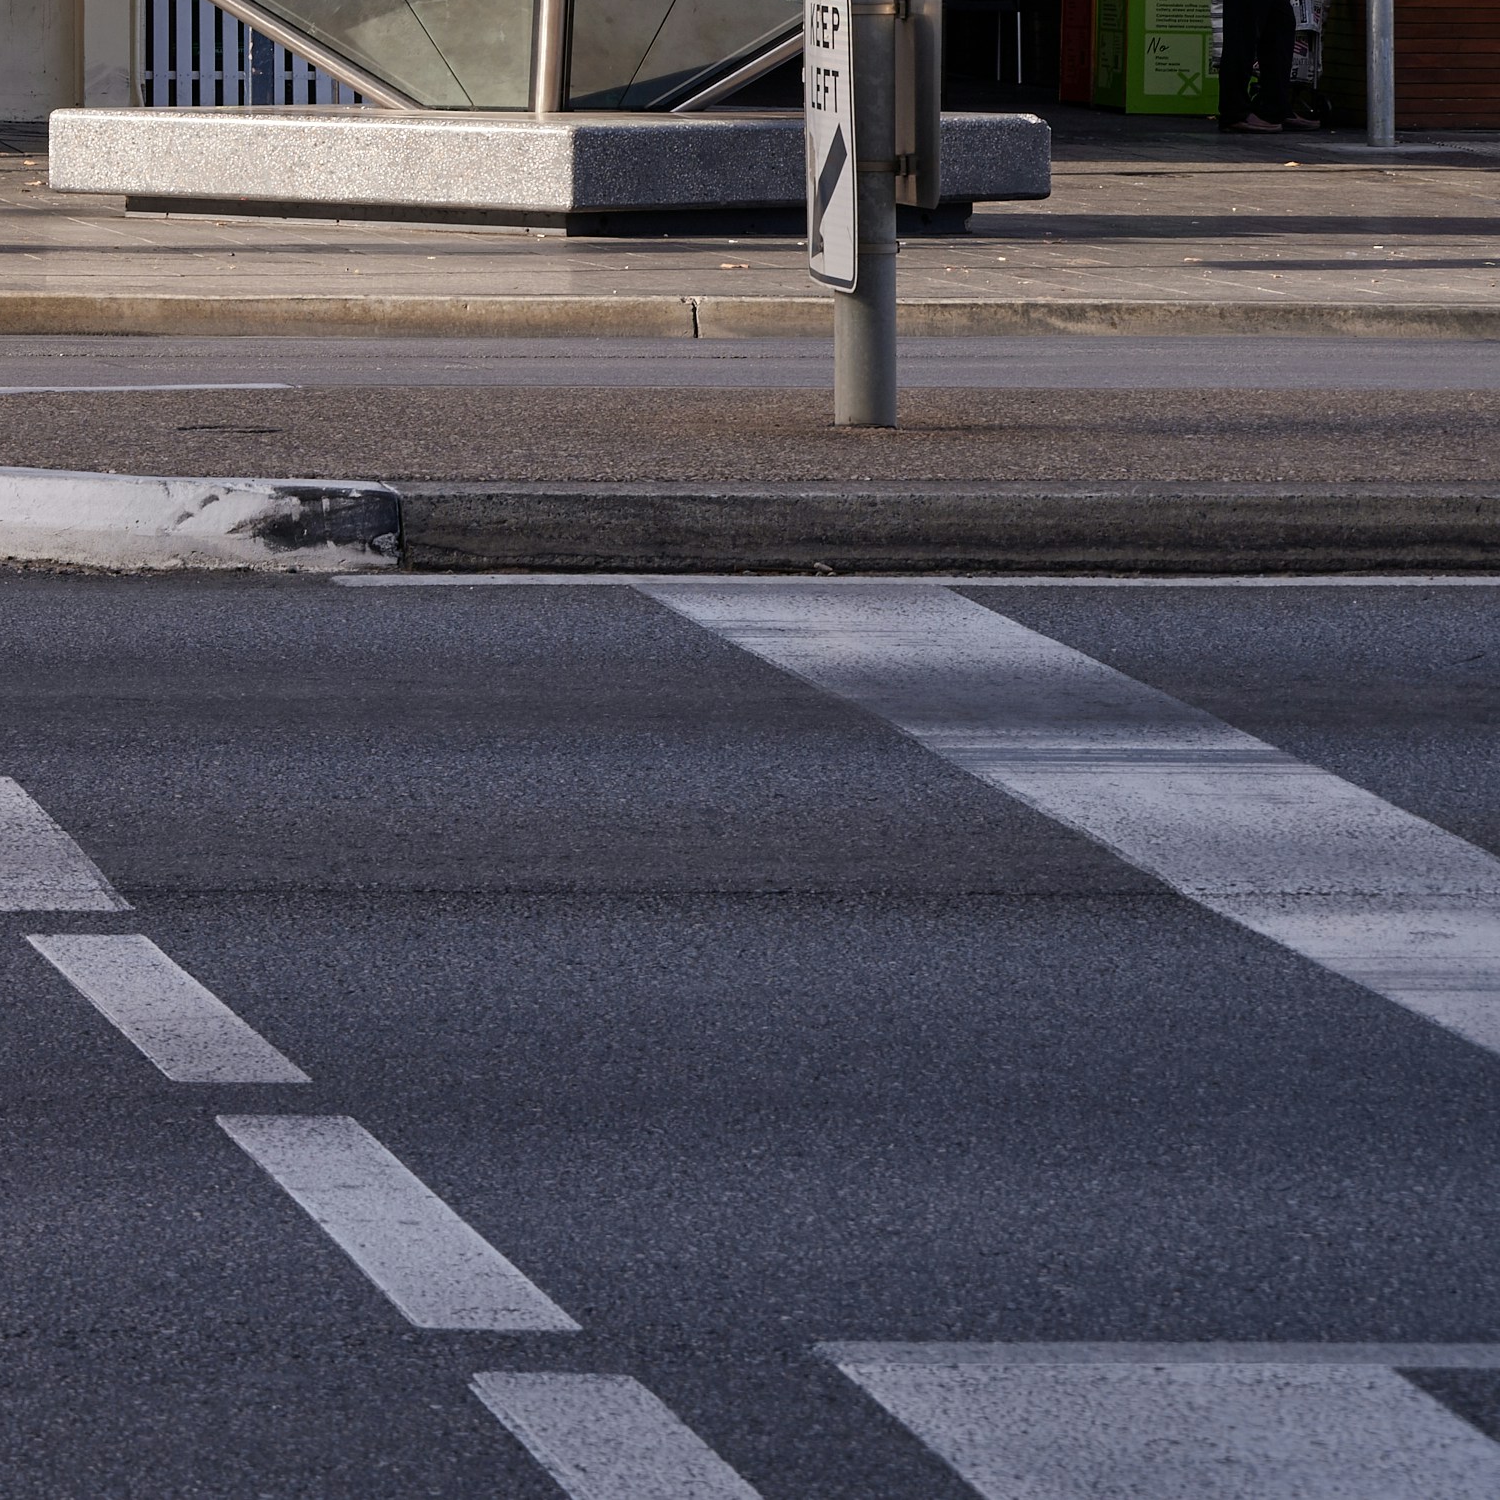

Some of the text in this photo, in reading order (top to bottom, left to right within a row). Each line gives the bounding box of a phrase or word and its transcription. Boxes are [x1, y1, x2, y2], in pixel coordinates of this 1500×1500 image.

[811, 4, 840, 50] KEEP
[1147, 37, 1169, 54] No
[811, 67, 839, 113] LEFT
